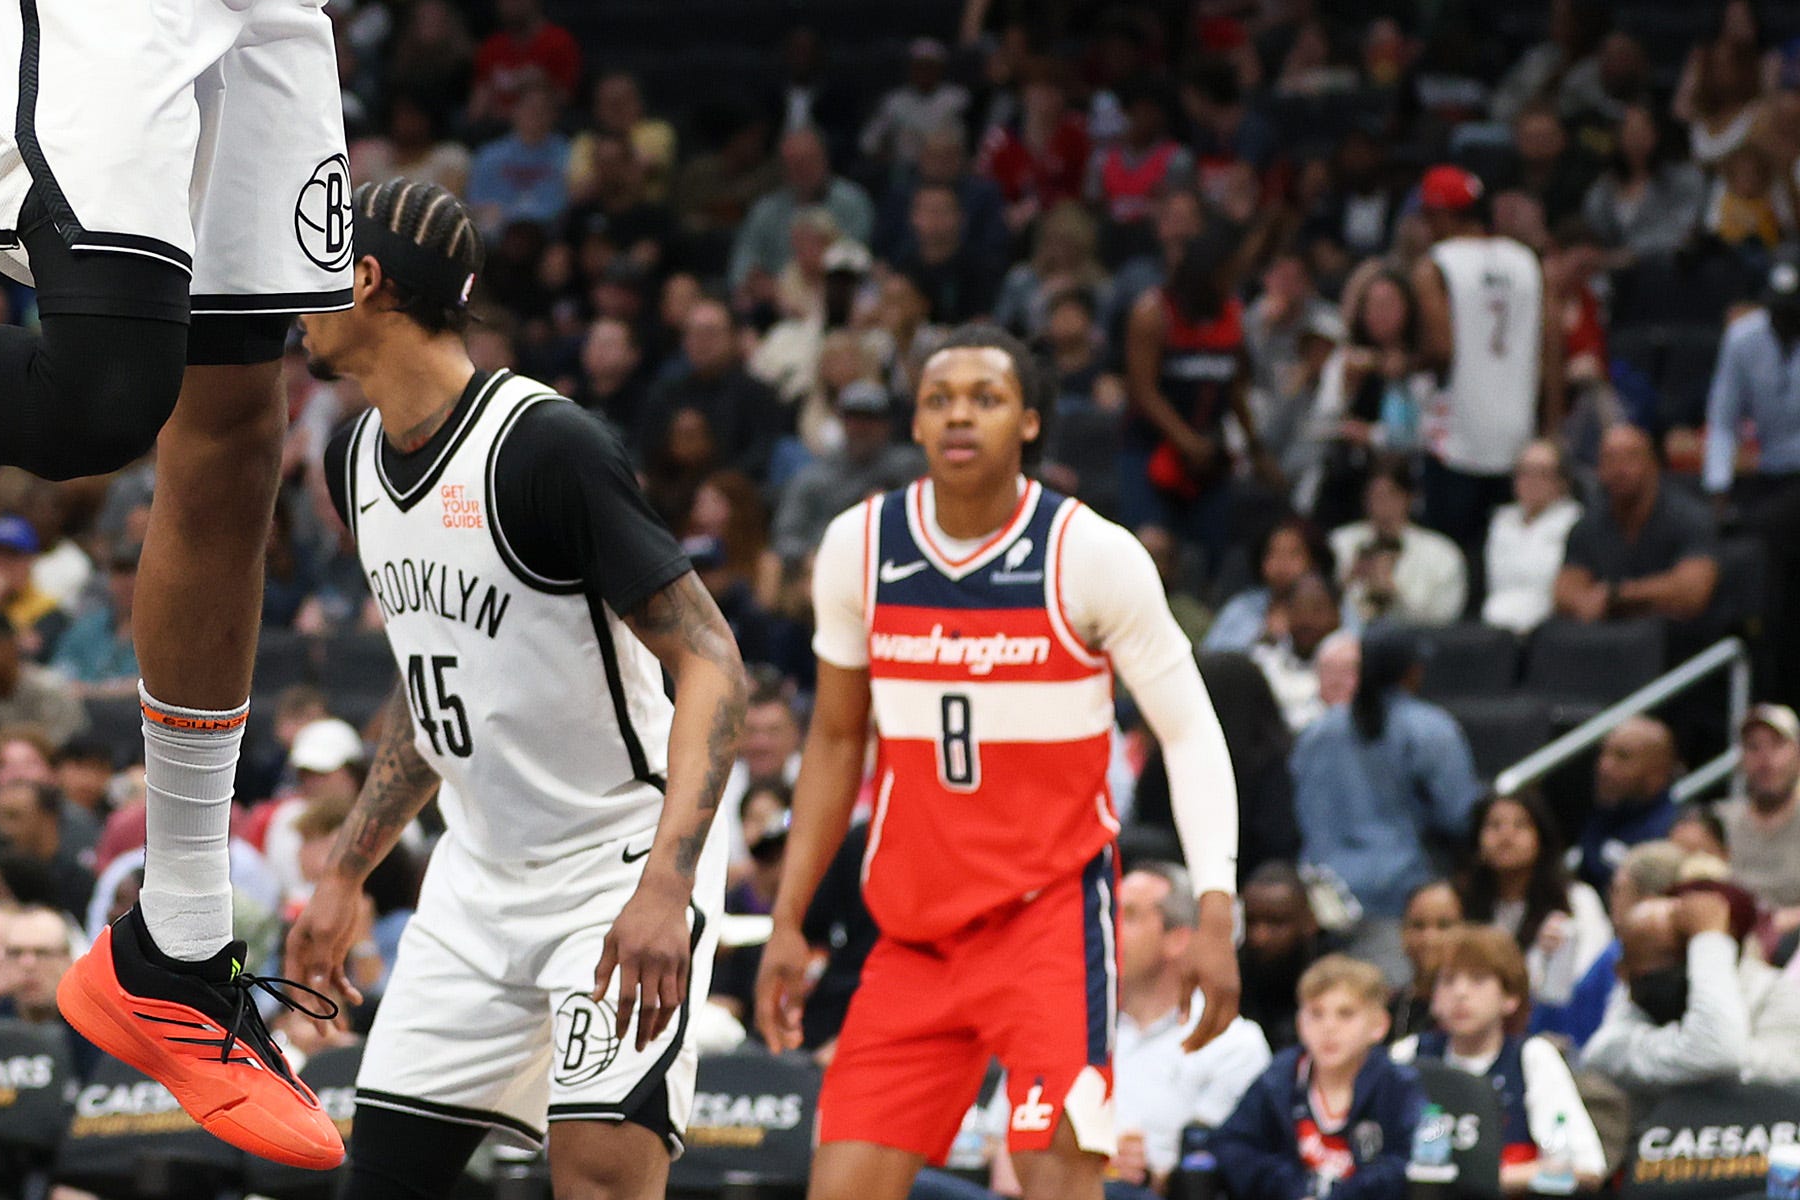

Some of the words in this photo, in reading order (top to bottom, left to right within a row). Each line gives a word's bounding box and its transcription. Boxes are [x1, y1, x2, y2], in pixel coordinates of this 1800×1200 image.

[440, 484, 465, 499] GET
[442, 499, 480, 514] YOUR
[442, 514, 485, 529] GUIDE
[371, 557, 512, 639] ROOKLYN
[871, 623, 1051, 676] washington
[408, 654, 473, 758] 45
[938, 691, 978, 789] 8
[1638, 1120, 1800, 1163] CAESAR
